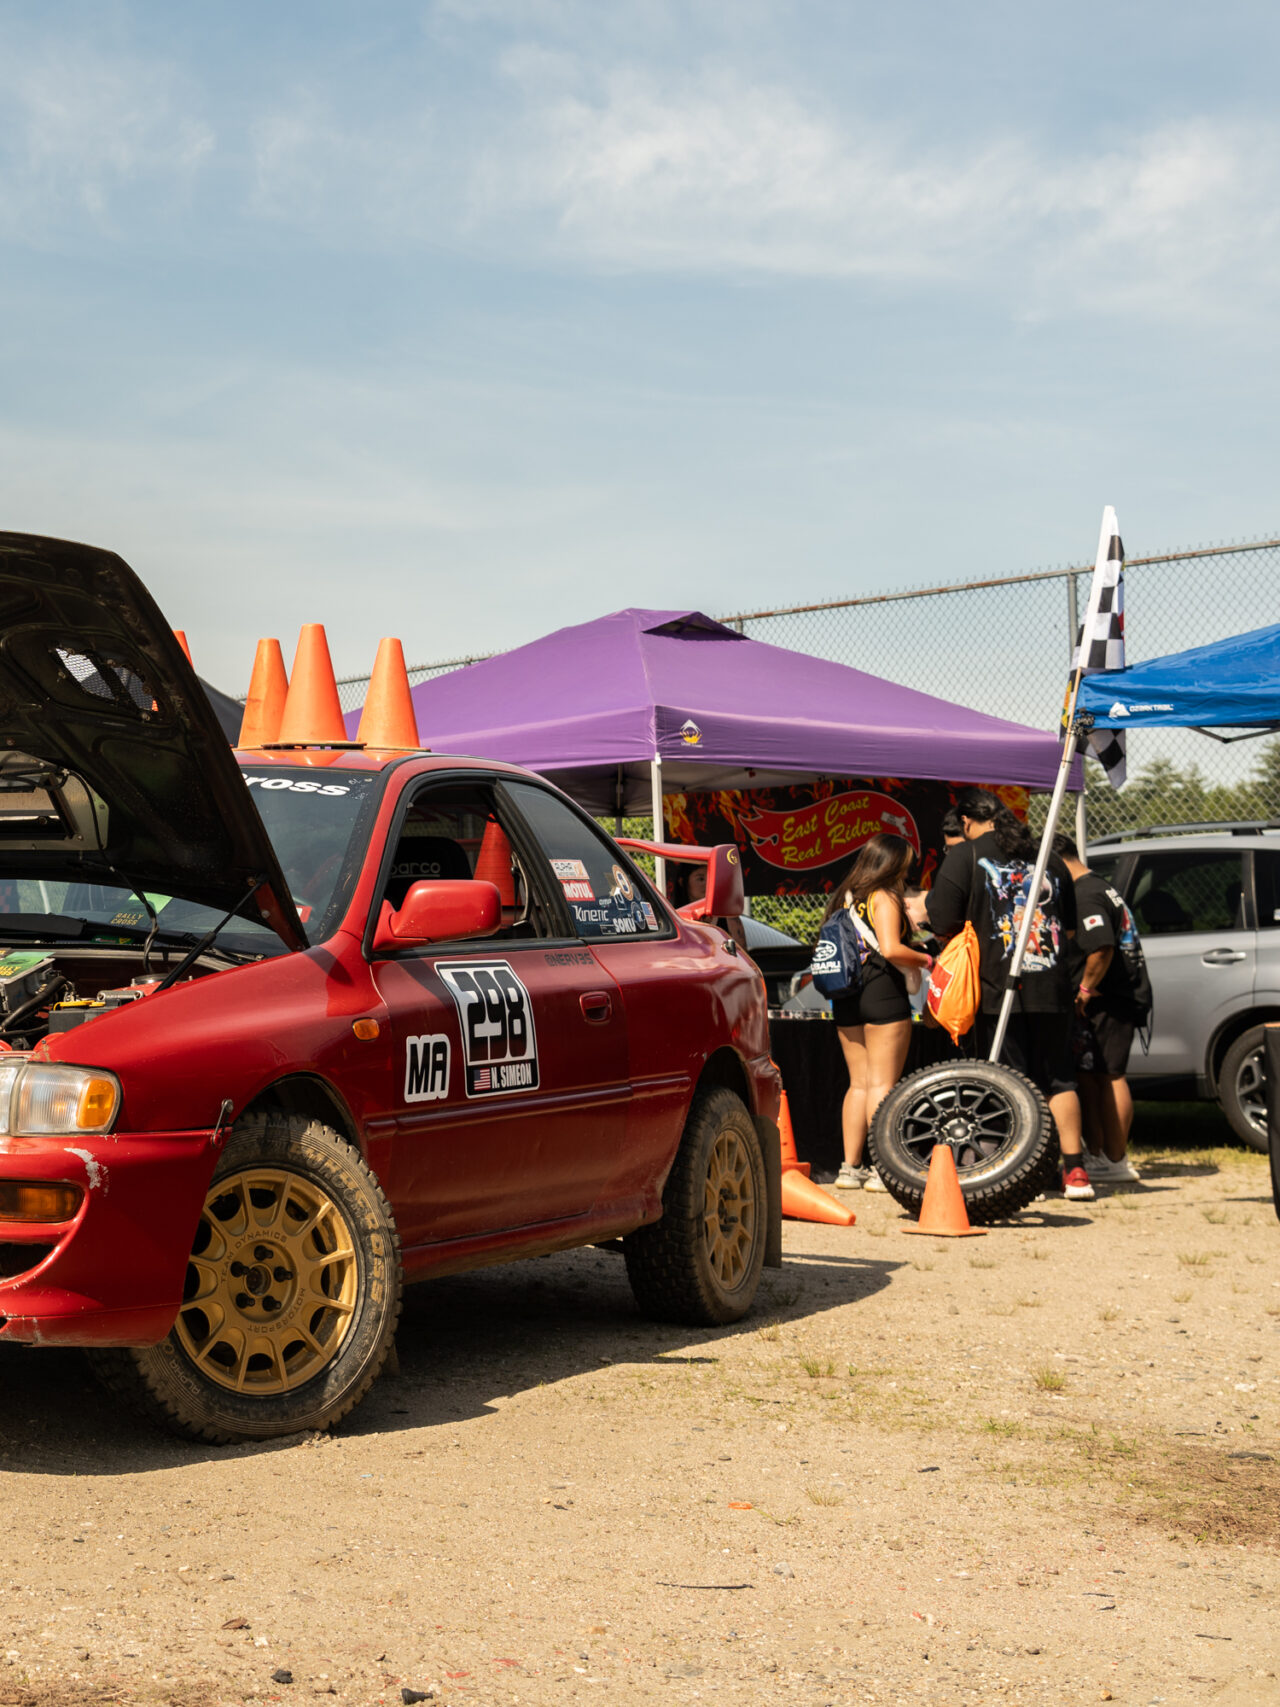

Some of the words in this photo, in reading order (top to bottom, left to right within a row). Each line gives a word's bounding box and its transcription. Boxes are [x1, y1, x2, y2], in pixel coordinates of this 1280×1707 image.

[243, 773, 350, 796] ross
[780, 837, 822, 866] Real
[826, 816, 883, 850] Riders
[782, 813, 818, 843] East
[824, 796, 870, 826] Coast
[563, 882, 594, 899] MOTUL
[451, 969, 528, 1063] 298
[407, 1041, 448, 1095] MA
[491, 1066, 500, 1089] N.
[500, 1062, 532, 1087] SIMEON
